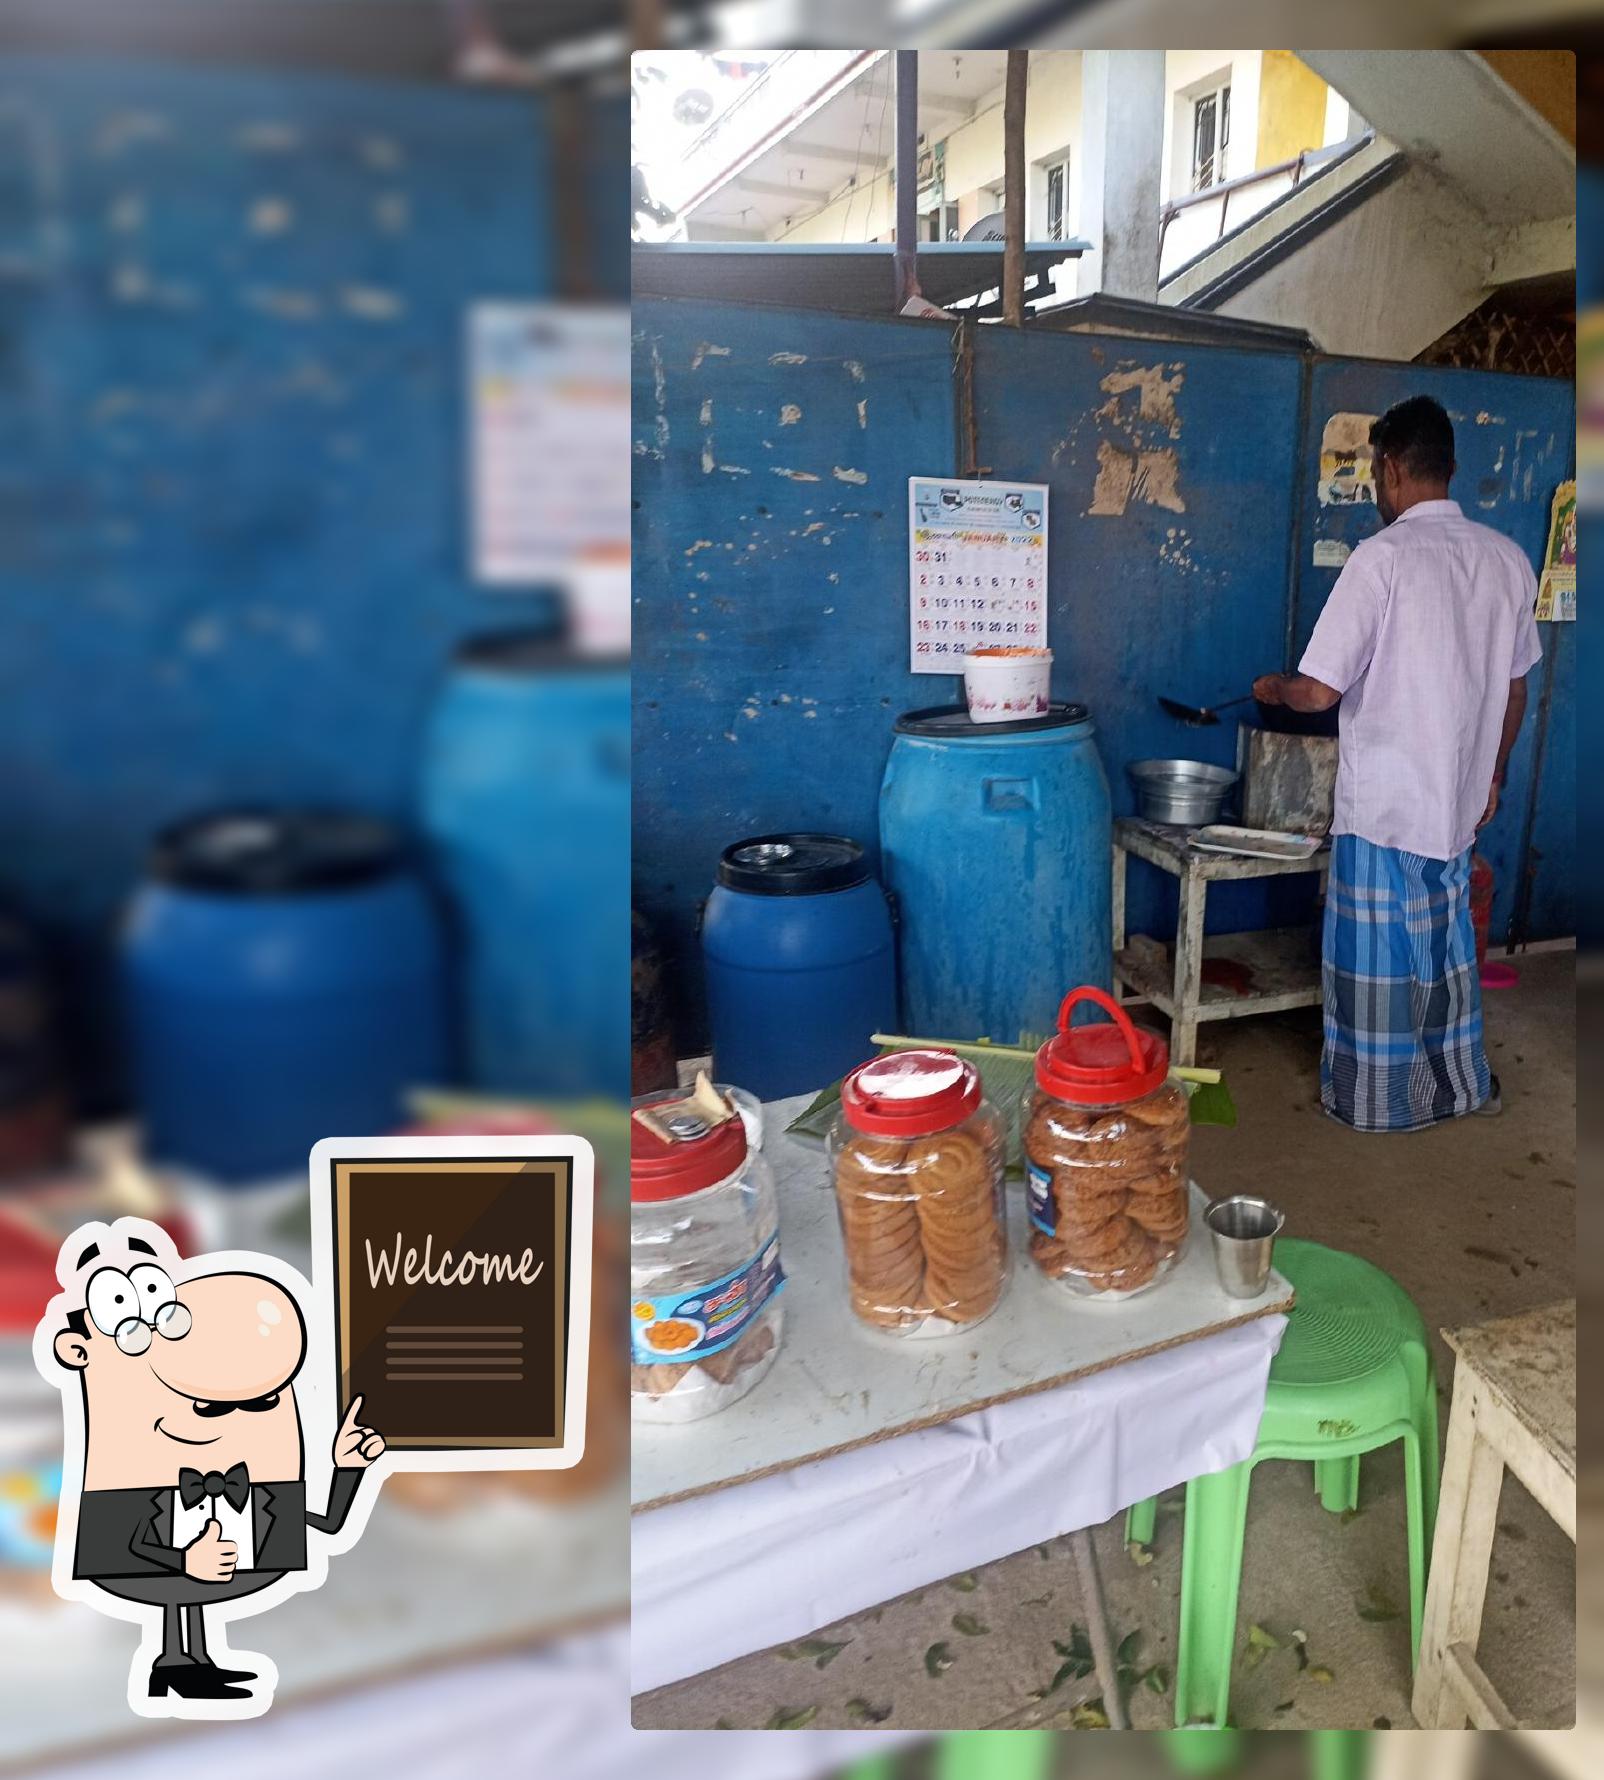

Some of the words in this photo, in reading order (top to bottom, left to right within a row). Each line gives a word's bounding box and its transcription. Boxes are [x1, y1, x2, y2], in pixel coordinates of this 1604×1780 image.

[934, 552, 947, 562] 31
[920, 574, 927, 585] 2
[938, 575, 945, 586] 3
[956, 576, 963, 586] 4
[974, 577, 981, 587] 5
[991, 577, 999, 587] 6
[1010, 578, 1017, 588] 7
[935, 598, 949, 608] 10
[954, 599, 965, 608] 11
[970, 599, 984, 609] 12
[935, 620, 948, 631] 17
[971, 621, 984, 632] 19
[989, 622, 1002, 632] 20
[1006, 622, 1018, 632] 21
[1024, 623, 1037, 633] 22
[935, 642, 948, 653] 24
